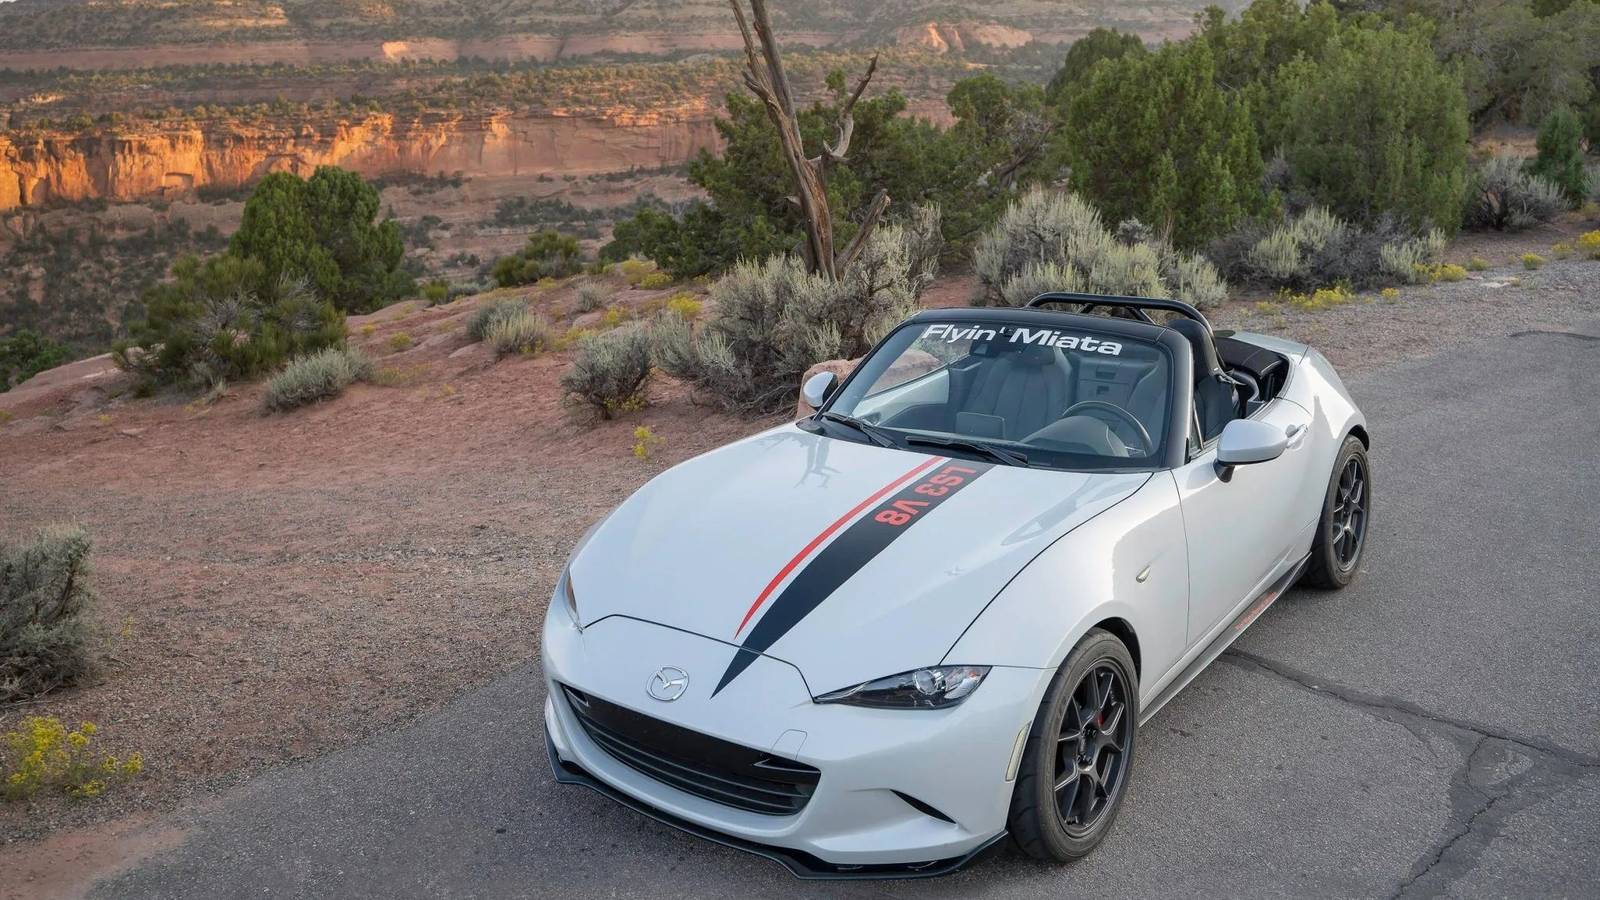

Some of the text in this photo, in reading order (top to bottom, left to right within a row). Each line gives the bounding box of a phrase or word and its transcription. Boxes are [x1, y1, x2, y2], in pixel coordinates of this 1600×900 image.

[1009, 327, 1122, 356] Miata
[874, 466, 976, 526] LS3 V8
